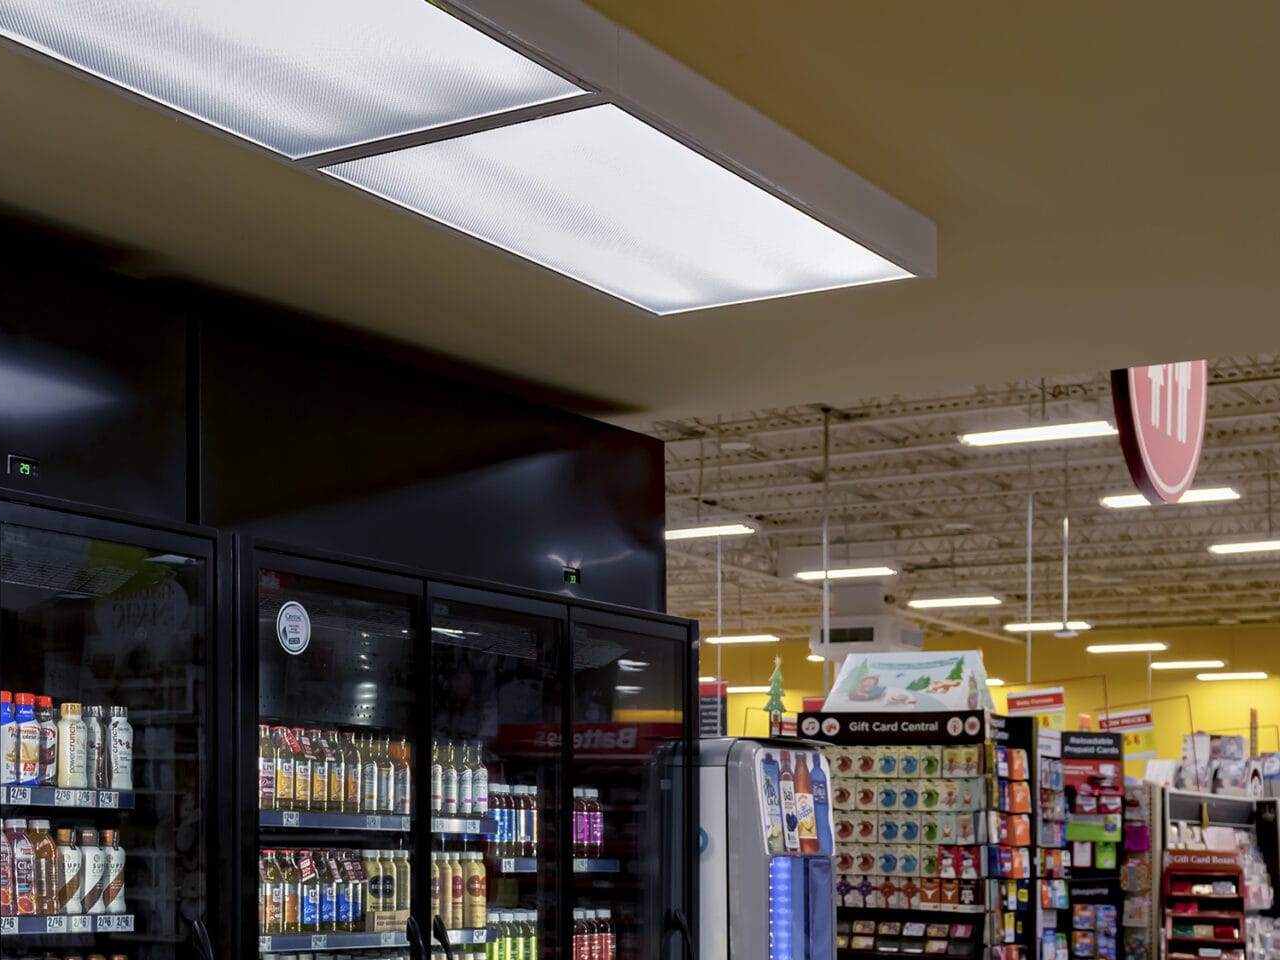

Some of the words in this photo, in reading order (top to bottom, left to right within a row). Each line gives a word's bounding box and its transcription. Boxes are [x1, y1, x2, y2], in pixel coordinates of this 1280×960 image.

[849, 720, 870, 732] Gift
[873, 720, 899, 732] Card
[901, 720, 939, 732] Central
[1070, 736, 1114, 746] Reloadable
[1064, 746, 1095, 757] Prepaid
[1097, 745, 1119, 755] Cards
[11, 787, 26, 800] 2/$6
